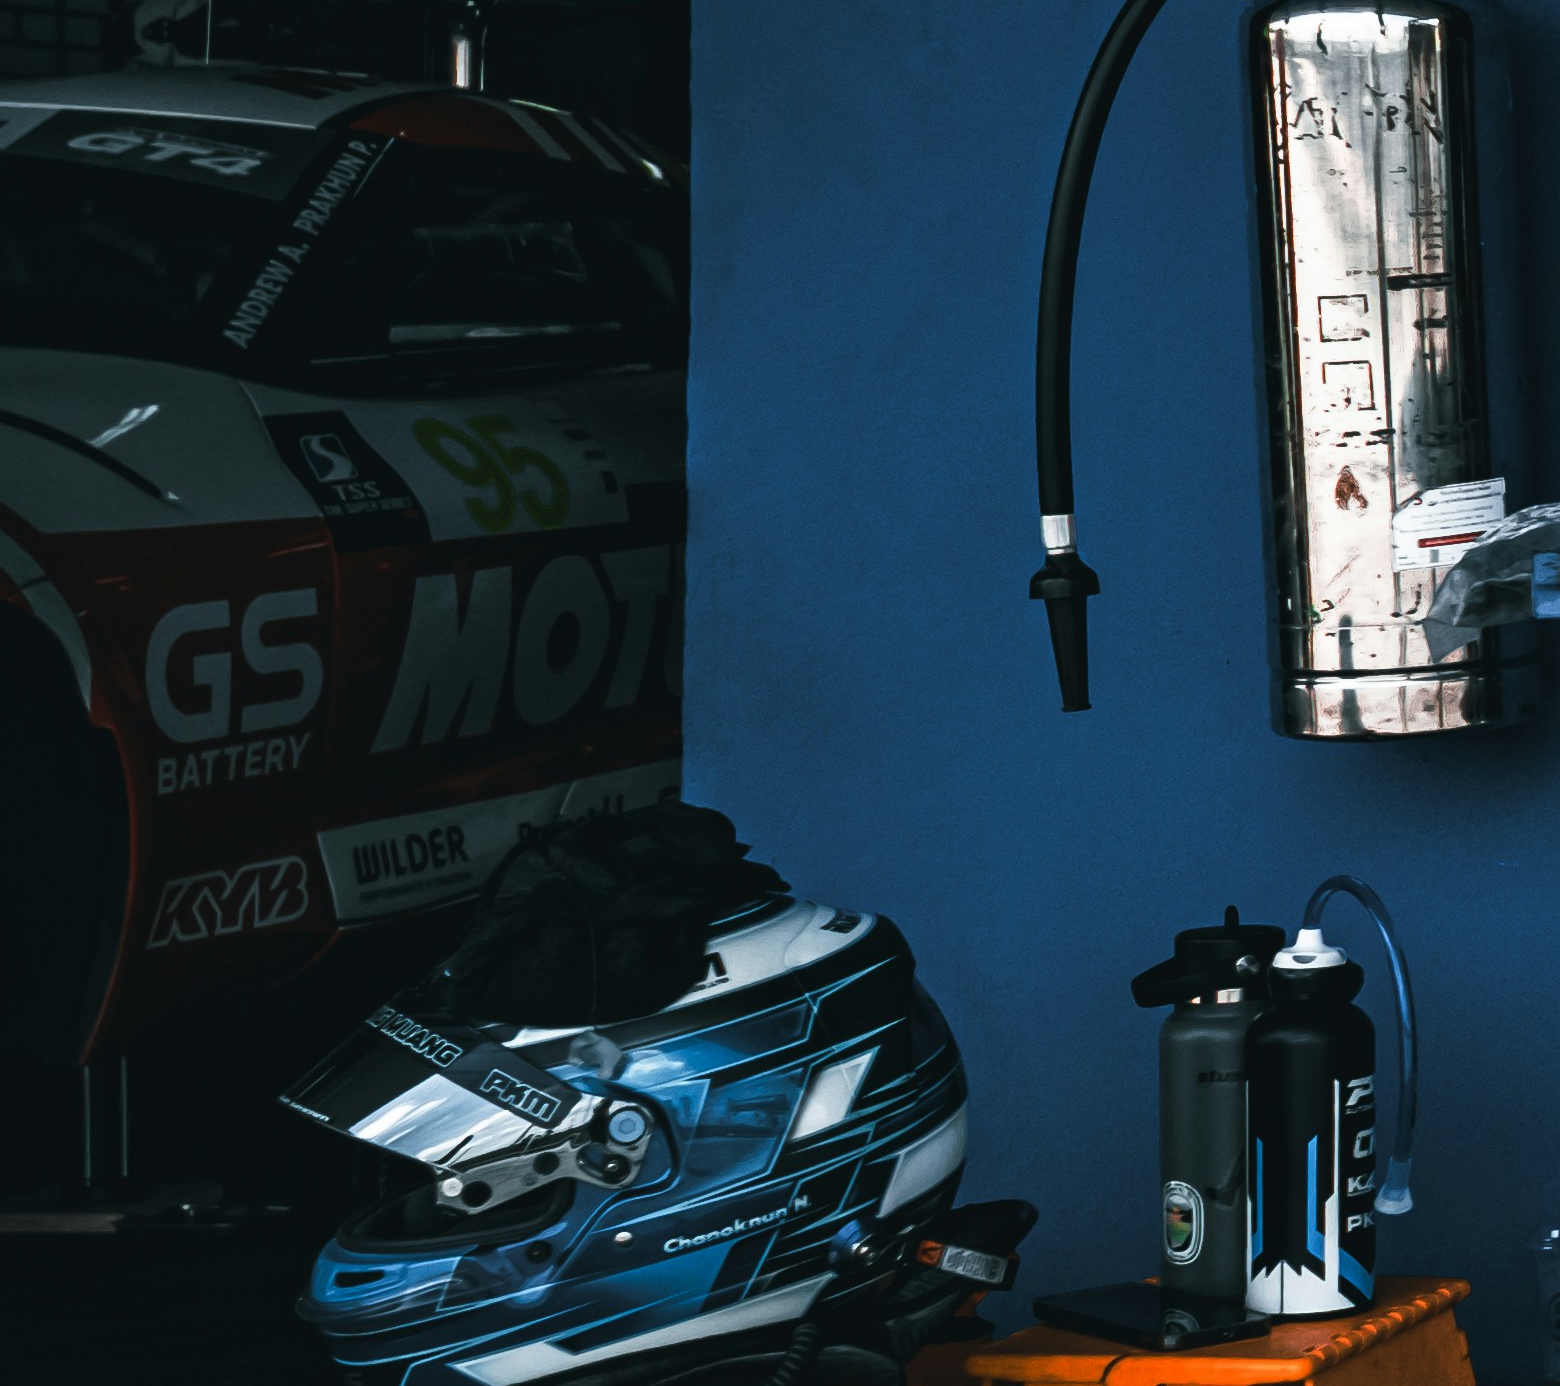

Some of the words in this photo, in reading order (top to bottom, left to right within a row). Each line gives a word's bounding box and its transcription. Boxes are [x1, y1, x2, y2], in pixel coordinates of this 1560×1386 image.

[67, 131, 262, 176] GT4
[293, 153, 366, 236] PRAKHUN
[222, 259, 295, 350] ANDREW
[330, 480, 382, 500] TSS
[413, 415, 572, 534] 95
[145, 588, 325, 744] GS
[370, 548, 682, 755] MOT
[156, 732, 313, 796] BATTERY
[352, 825, 469, 885] WILDER
[146, 854, 310, 951] KYB
